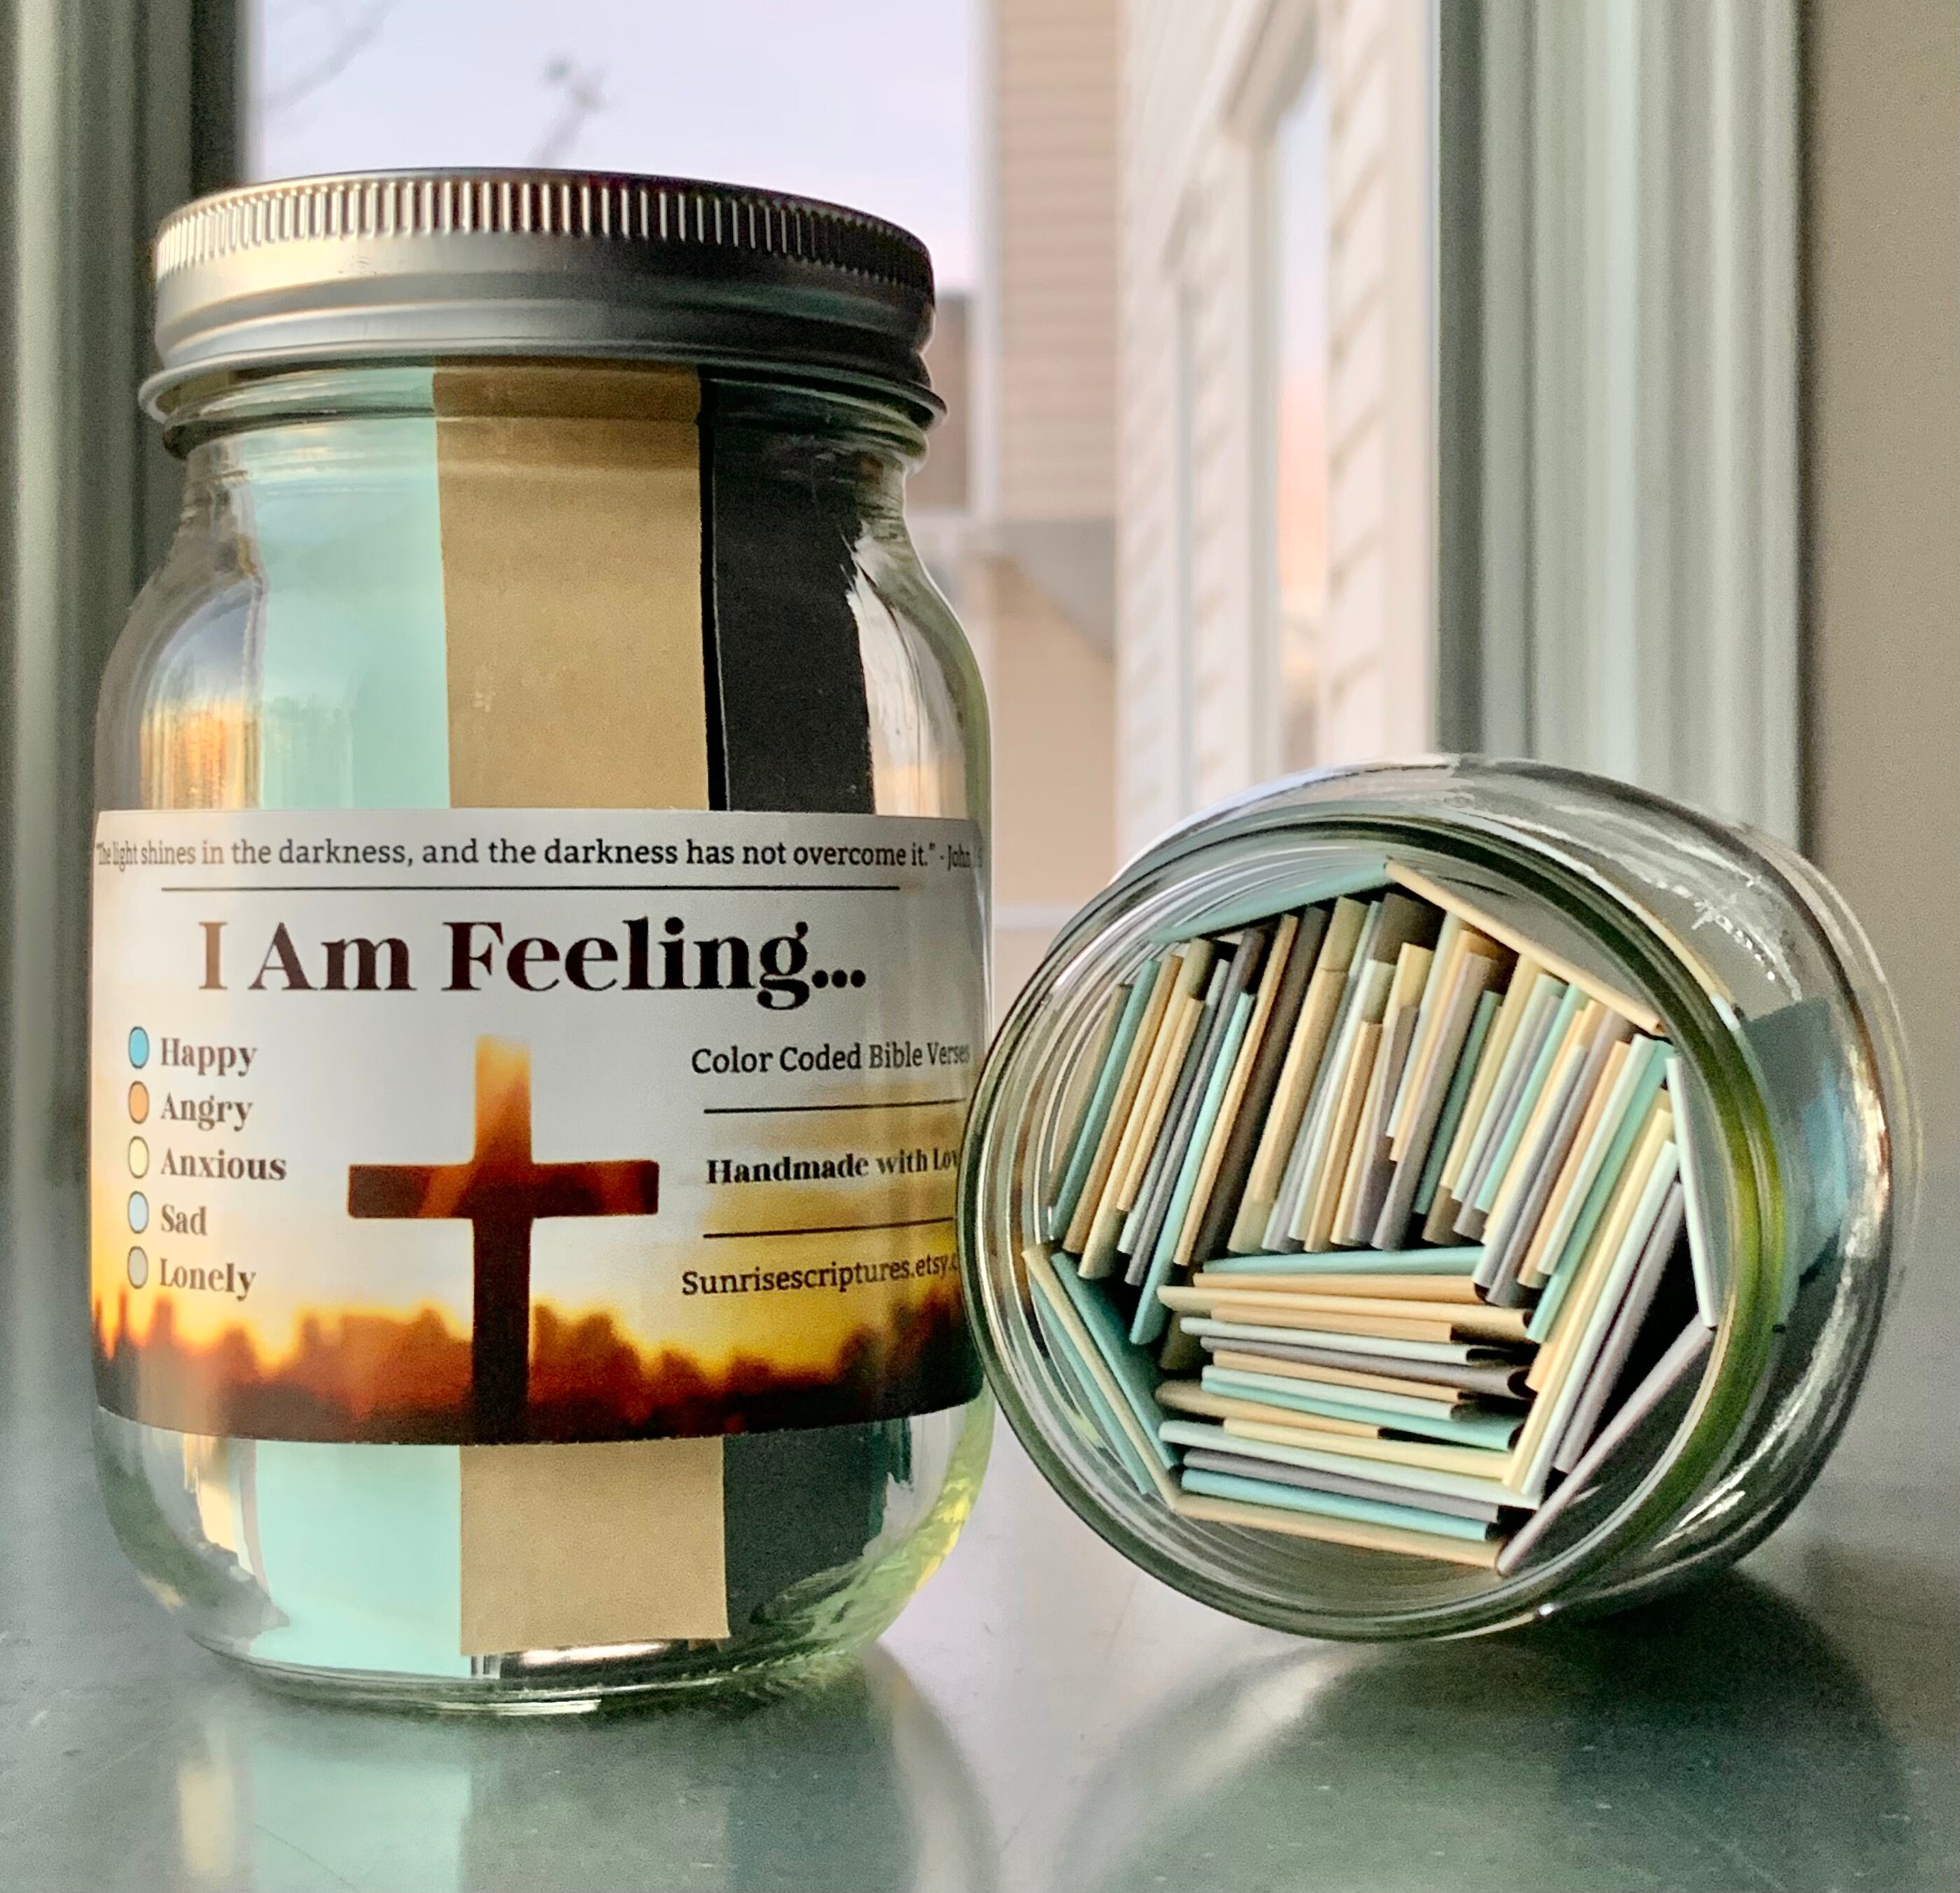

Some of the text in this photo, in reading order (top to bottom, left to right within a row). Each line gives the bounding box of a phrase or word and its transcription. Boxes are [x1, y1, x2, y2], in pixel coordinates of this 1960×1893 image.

[112, 840, 139, 873] light
[141, 840, 196, 866] shines
[201, 839, 225, 865] in
[231, 838, 272, 864] the
[279, 838, 413, 867] darkness,
[422, 838, 479, 864] and
[488, 838, 536, 864] the
[544, 838, 679, 864] darkness
[686, 838, 735, 865] has
[742, 842, 786, 865] not
[793, 846, 906, 866] overcome
[198, 916, 866, 1011] I Am Feeling...
[160, 1037, 257, 1076] Happy
[691, 1045, 774, 1074] Color
[779, 1042, 862, 1072] Coded
[868, 1040, 923, 1069] Bible
[160, 1093, 253, 1132] Angry
[161, 1149, 286, 1181] Anxious
[707, 1153, 869, 1184] Handmade
[876, 1149, 928, 1174] with
[161, 1204, 207, 1236] Sad
[160, 1258, 256, 1302] Lonely
